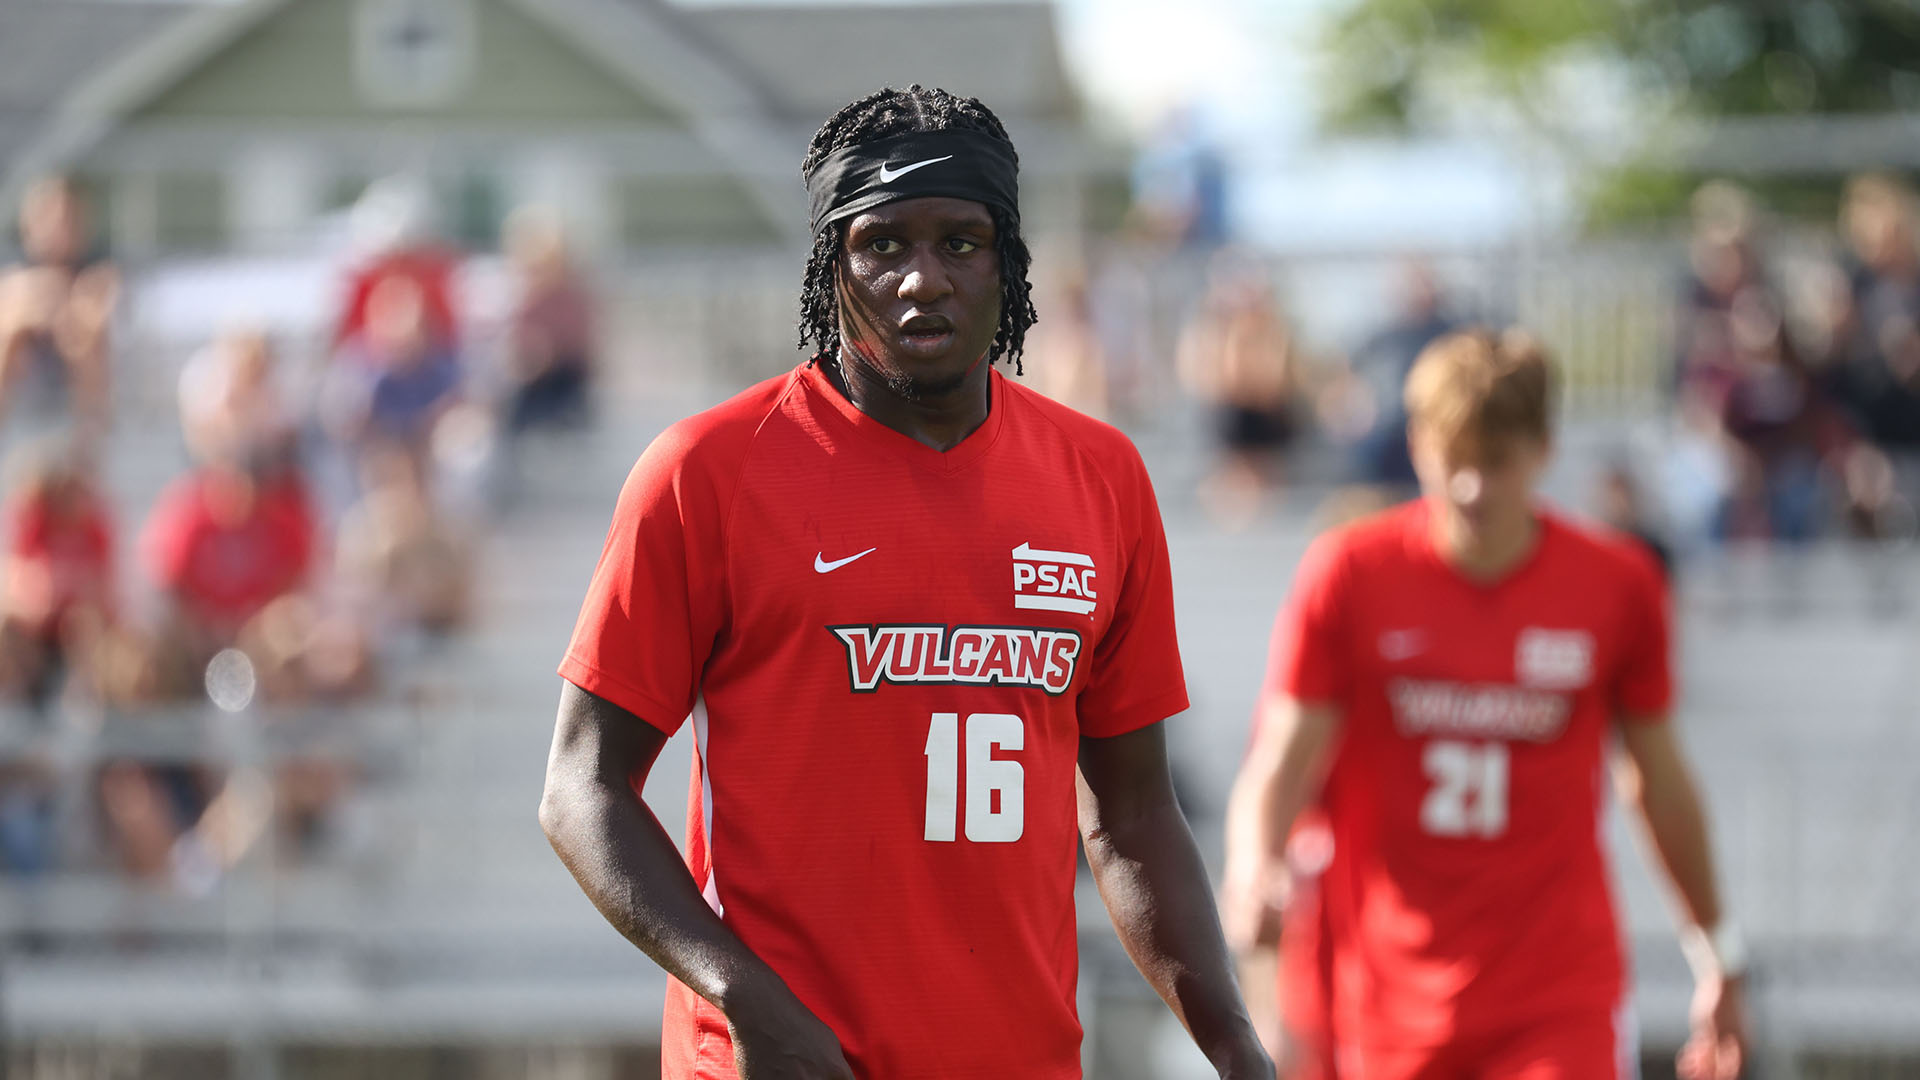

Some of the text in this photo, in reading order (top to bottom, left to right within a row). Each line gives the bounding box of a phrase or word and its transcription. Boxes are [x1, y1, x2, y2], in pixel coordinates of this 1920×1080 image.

[1013, 562, 1097, 599] PSAC
[827, 624, 1082, 695] VULCANS
[924, 712, 1025, 843] 16
[1421, 739, 1509, 839] 21
